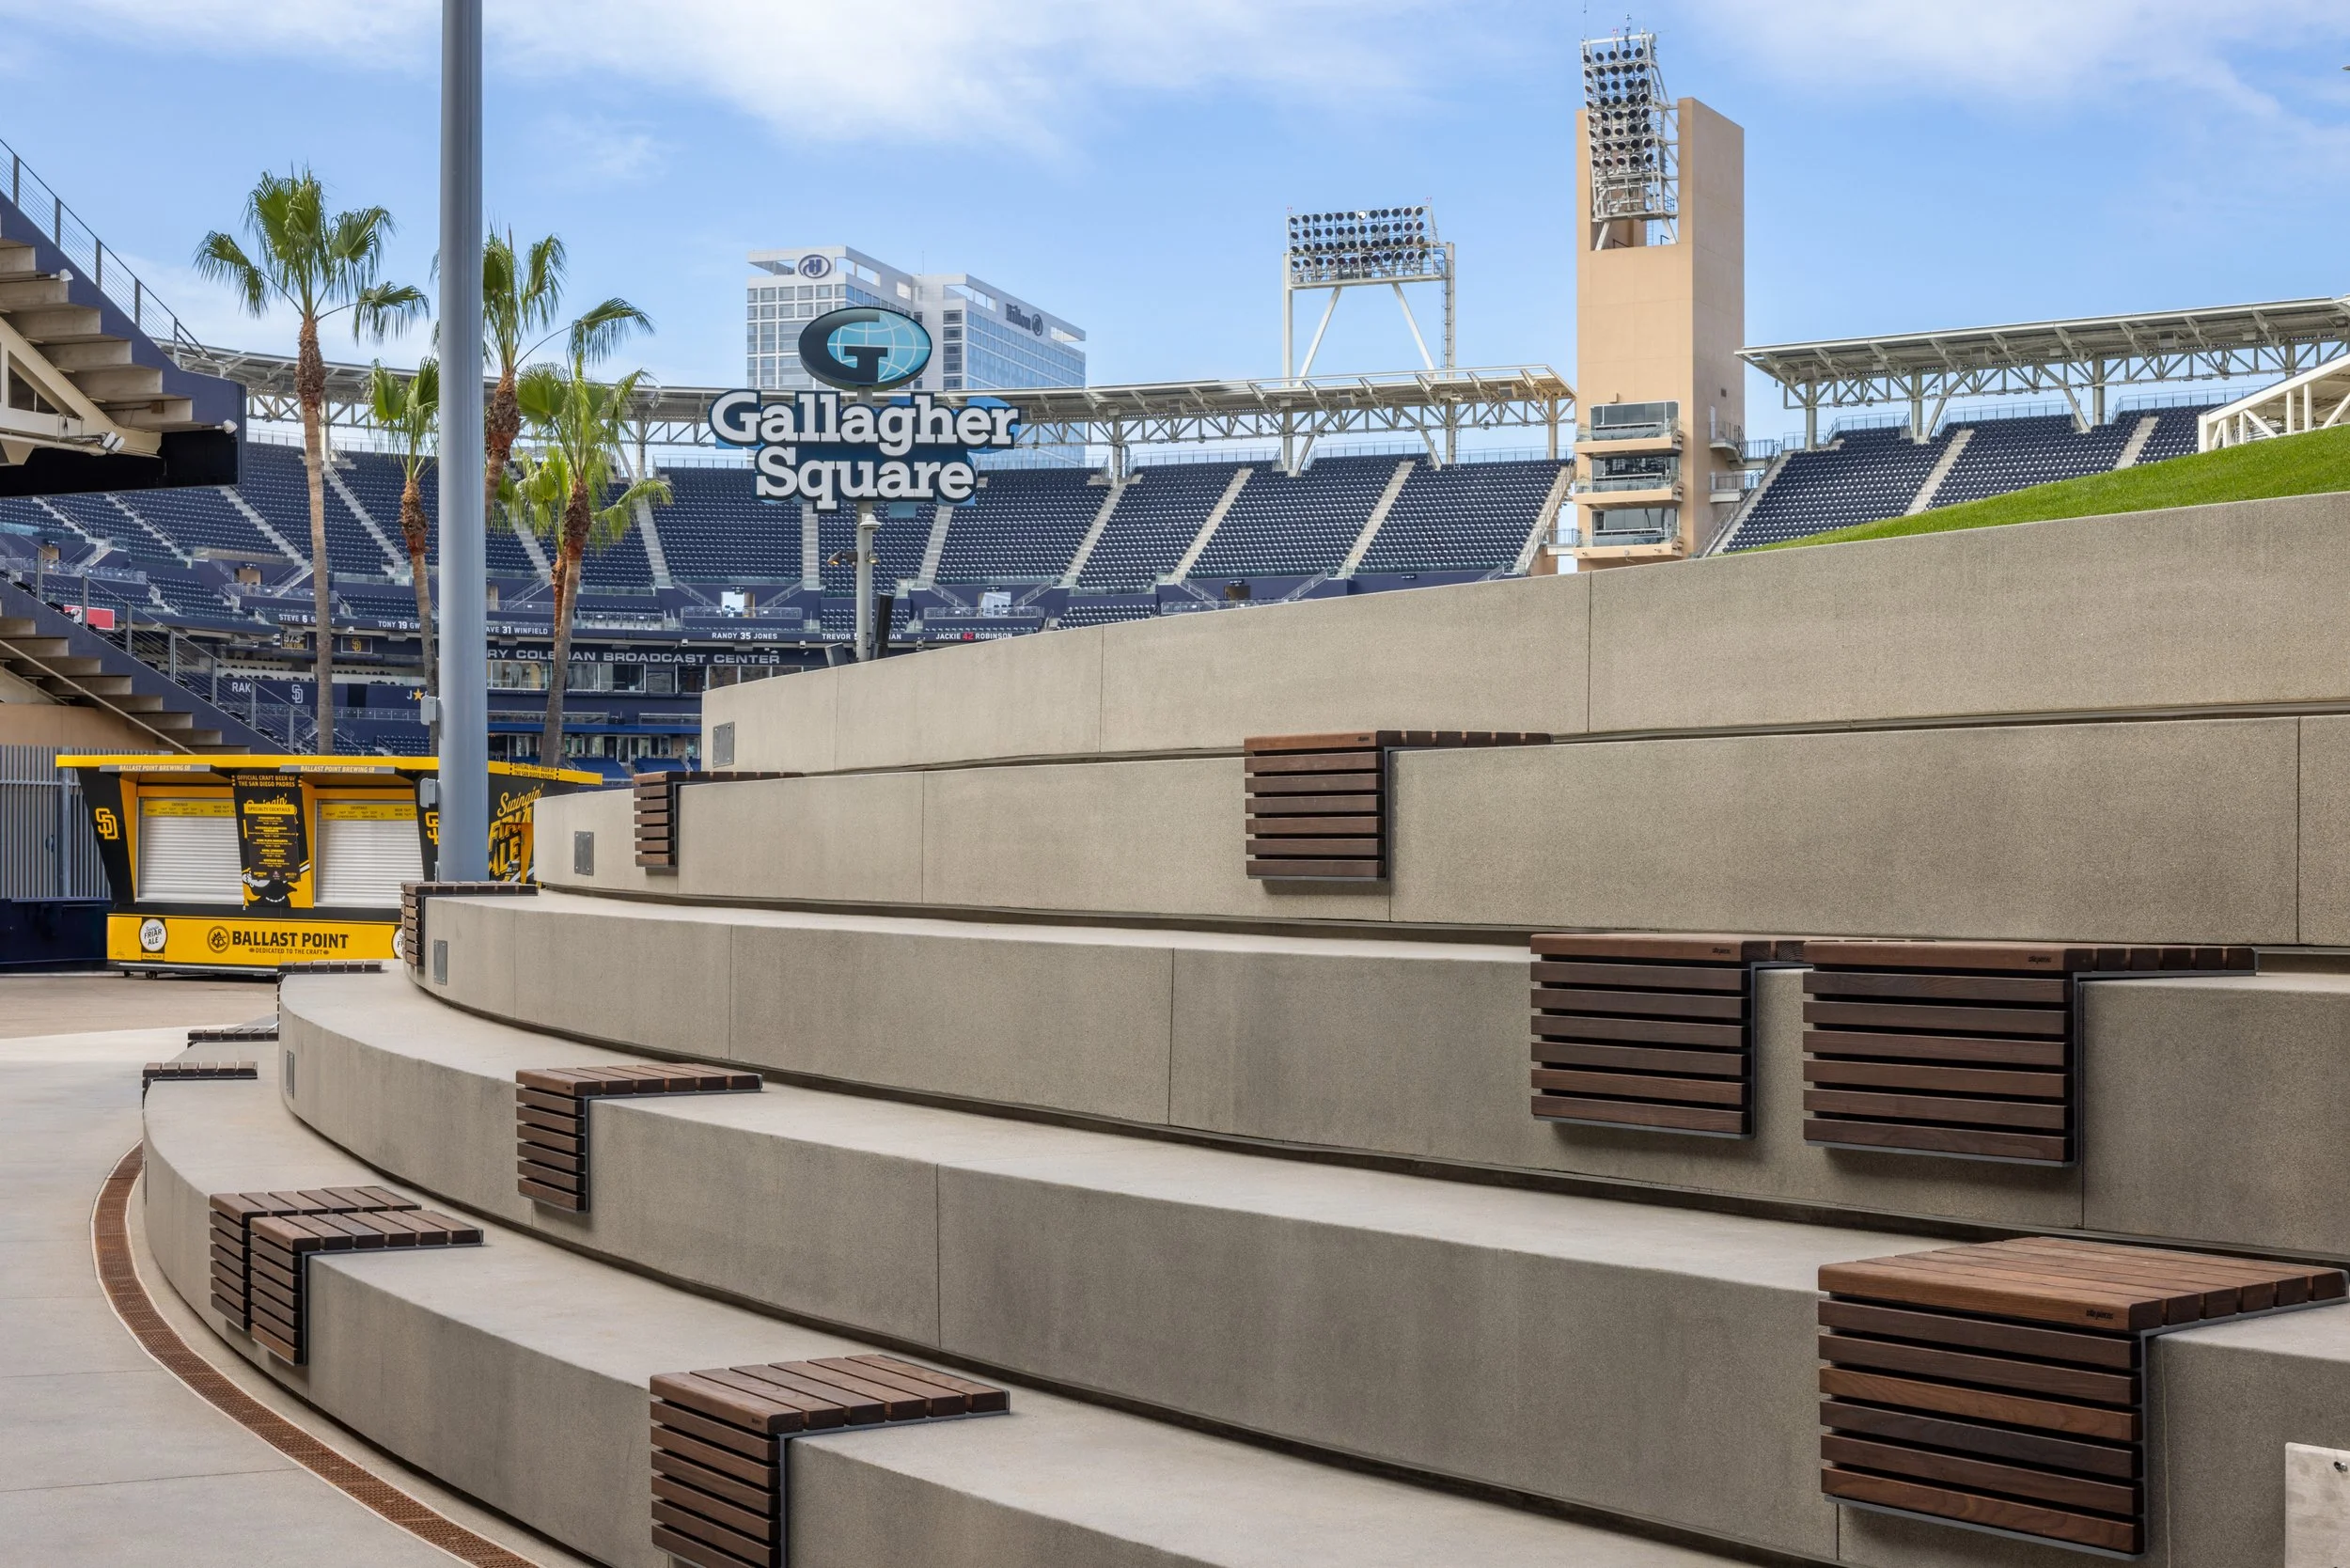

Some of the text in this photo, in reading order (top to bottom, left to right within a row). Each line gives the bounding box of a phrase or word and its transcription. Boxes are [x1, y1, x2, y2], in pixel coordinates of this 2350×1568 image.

[711, 391, 1019, 456] Gallagher
[756, 447, 975, 510] Square
[278, 614, 299, 622] STEVE
[302, 615, 307, 623] 6
[398, 620, 408, 629] 19
[740, 632, 751, 640] 35
[962, 632, 974, 640] 42
[516, 650, 596, 661] COLEAN
[603, 652, 706, 663] BROADCAST
[713, 653, 780, 664] CENTER
[231, 682, 251, 693] RAK
[144, 928, 163, 939] FRIAR
[148, 937, 159, 946] ALE
[232, 931, 349, 949] BALLAST POINT
